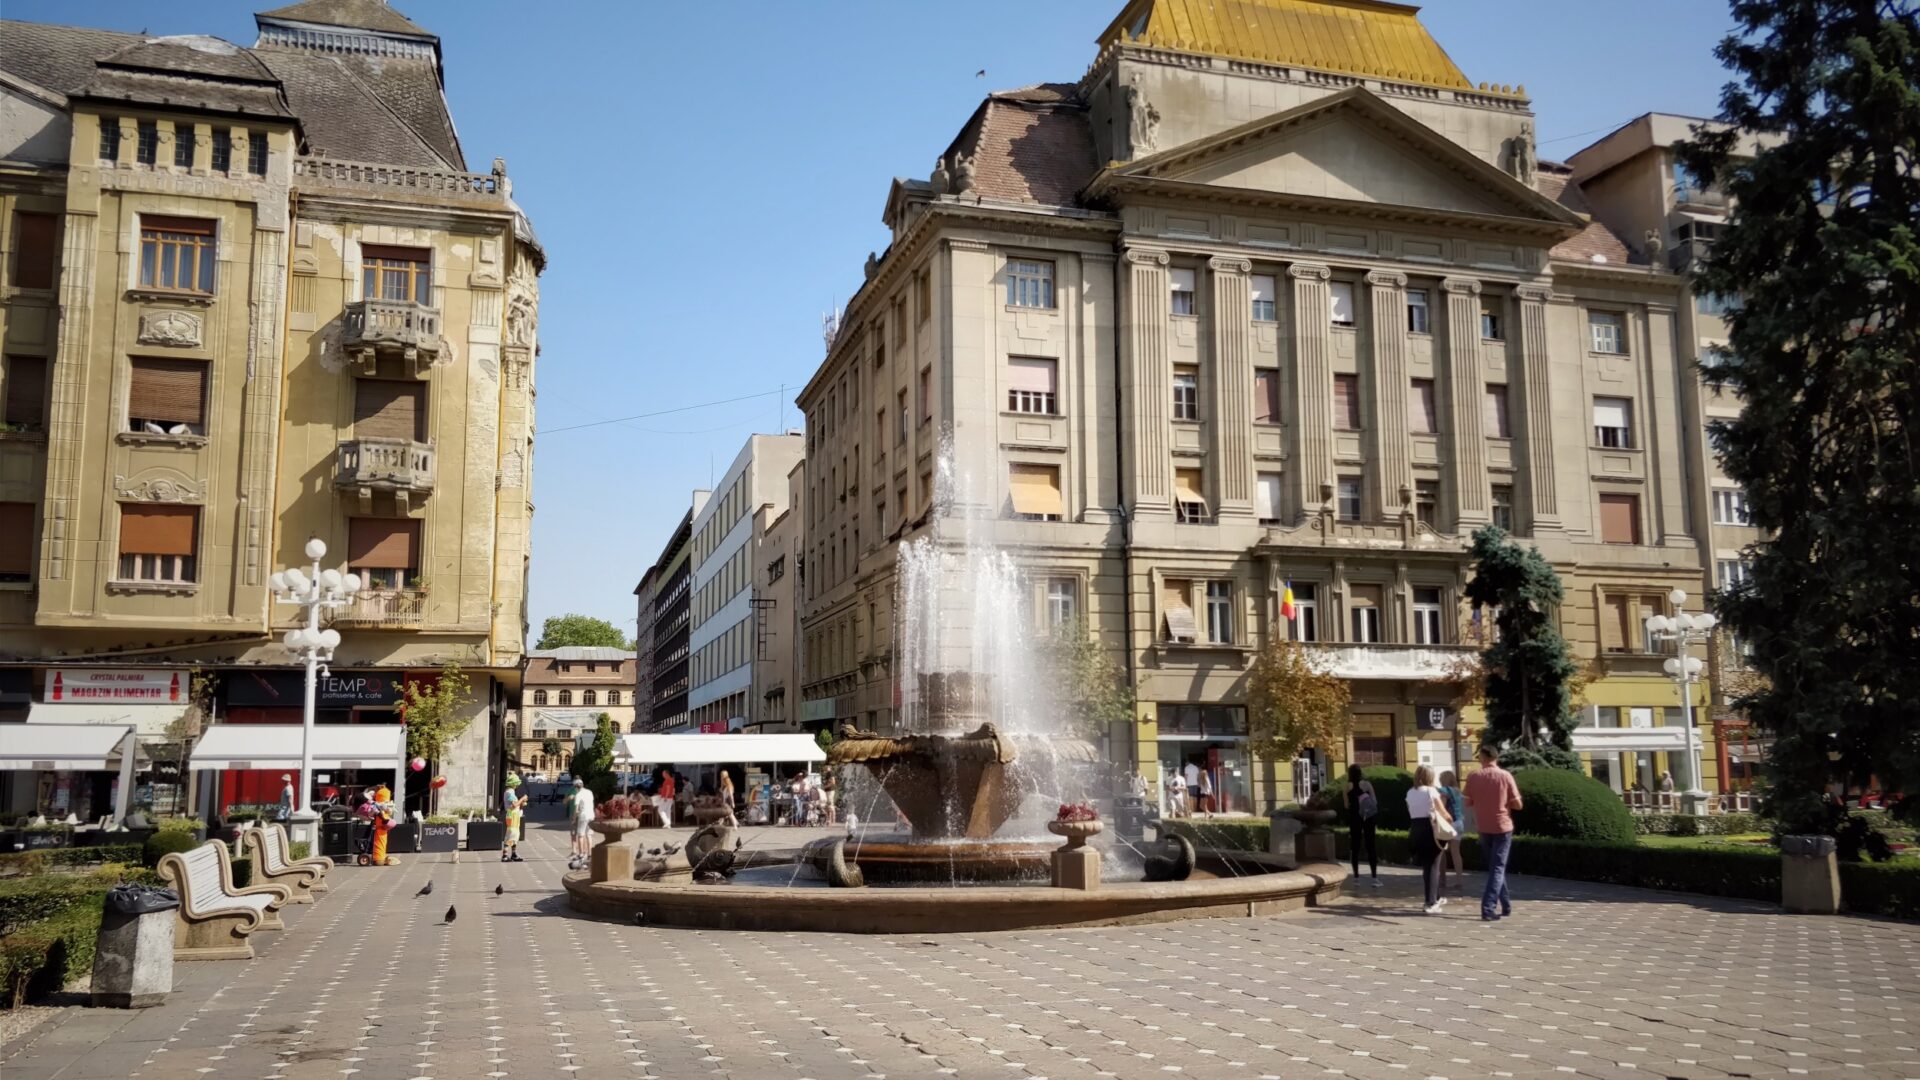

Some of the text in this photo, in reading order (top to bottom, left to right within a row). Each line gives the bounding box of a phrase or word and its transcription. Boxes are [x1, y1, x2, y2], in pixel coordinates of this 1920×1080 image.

[320, 678, 382, 692] TEMPO
[71, 688, 162, 698] MAGAZIN ALIMENTAR
[424, 827, 455, 836] TEMPO
